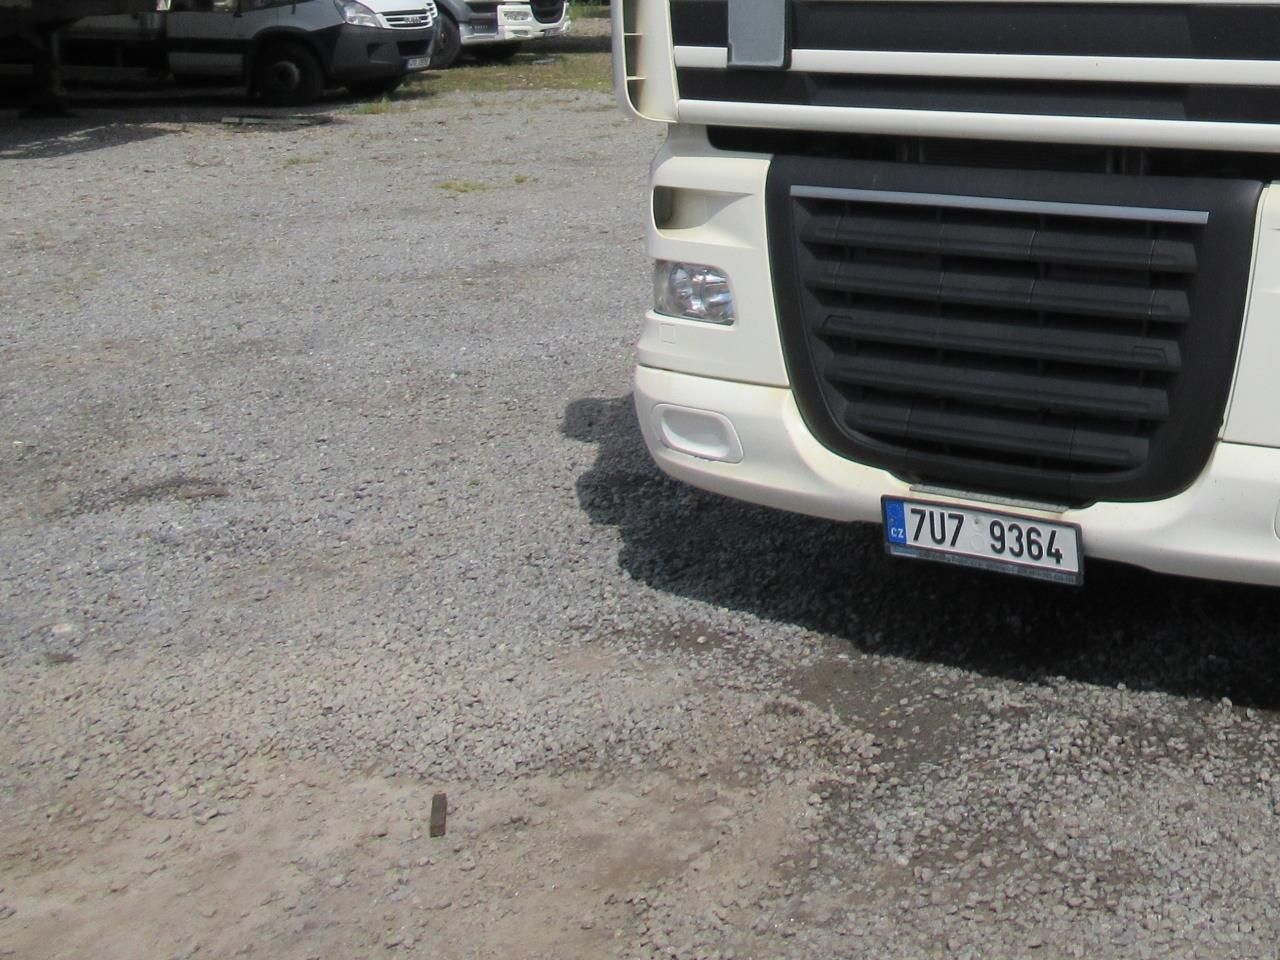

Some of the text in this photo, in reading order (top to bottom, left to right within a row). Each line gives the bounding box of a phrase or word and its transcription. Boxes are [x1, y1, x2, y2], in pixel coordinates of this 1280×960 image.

[890, 527, 905, 539] CZ
[910, 507, 1063, 565] 7U7 9364
